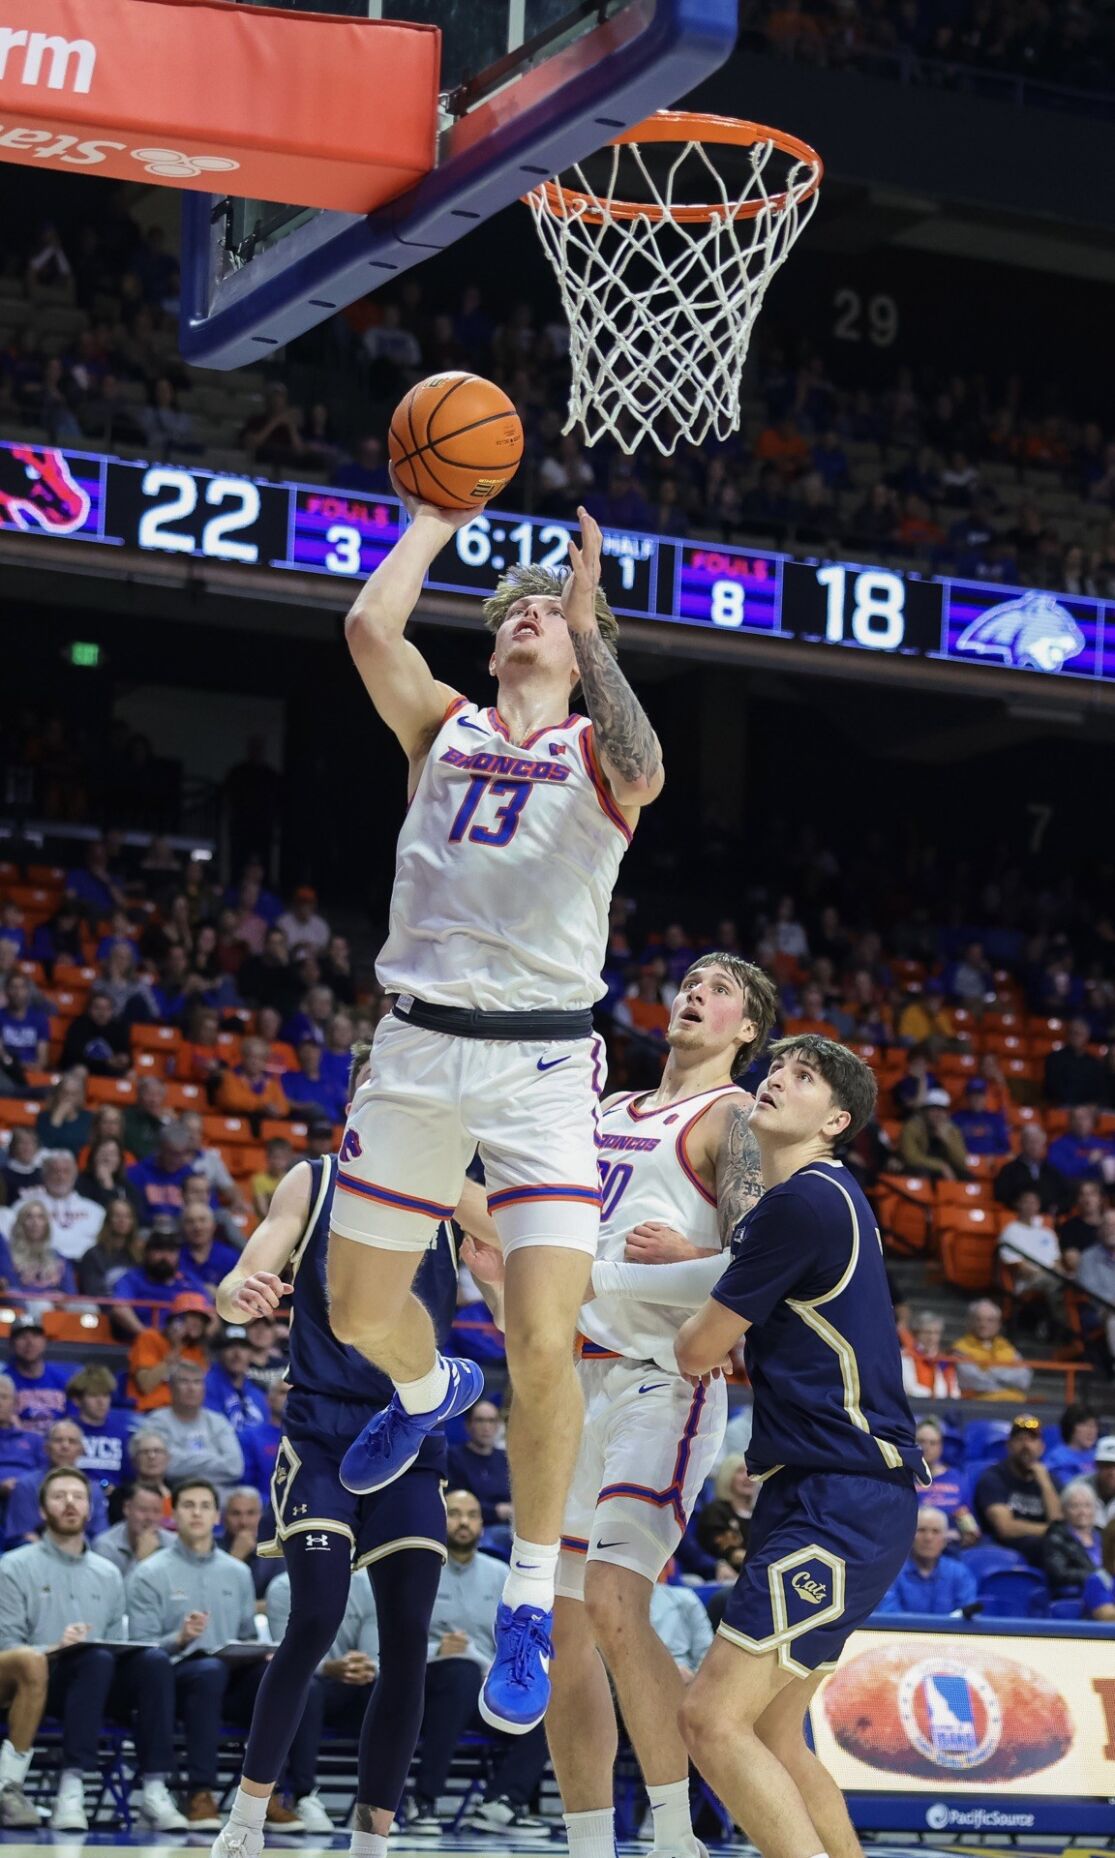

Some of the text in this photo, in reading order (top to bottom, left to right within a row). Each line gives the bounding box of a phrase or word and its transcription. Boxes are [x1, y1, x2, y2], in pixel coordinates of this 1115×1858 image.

[0, 27, 96, 94] rm
[0, 124, 127, 165] Sta
[834, 290, 897, 346] 29
[138, 468, 261, 563] 22
[306, 494, 389, 528] FOULS
[325, 525, 362, 575] 3
[456, 514, 571, 573] 6:12
[690, 549, 768, 581] FOULS
[618, 556, 635, 590] 1
[711, 579, 745, 628] 8
[816, 565, 905, 650] 18
[439, 746, 572, 782] BRONCOS
[448, 773, 534, 848] 13
[1026, 802, 1053, 854] 7
[792, 1571, 827, 1601] Cats
[949, 1808, 1035, 1830] PacificSource
